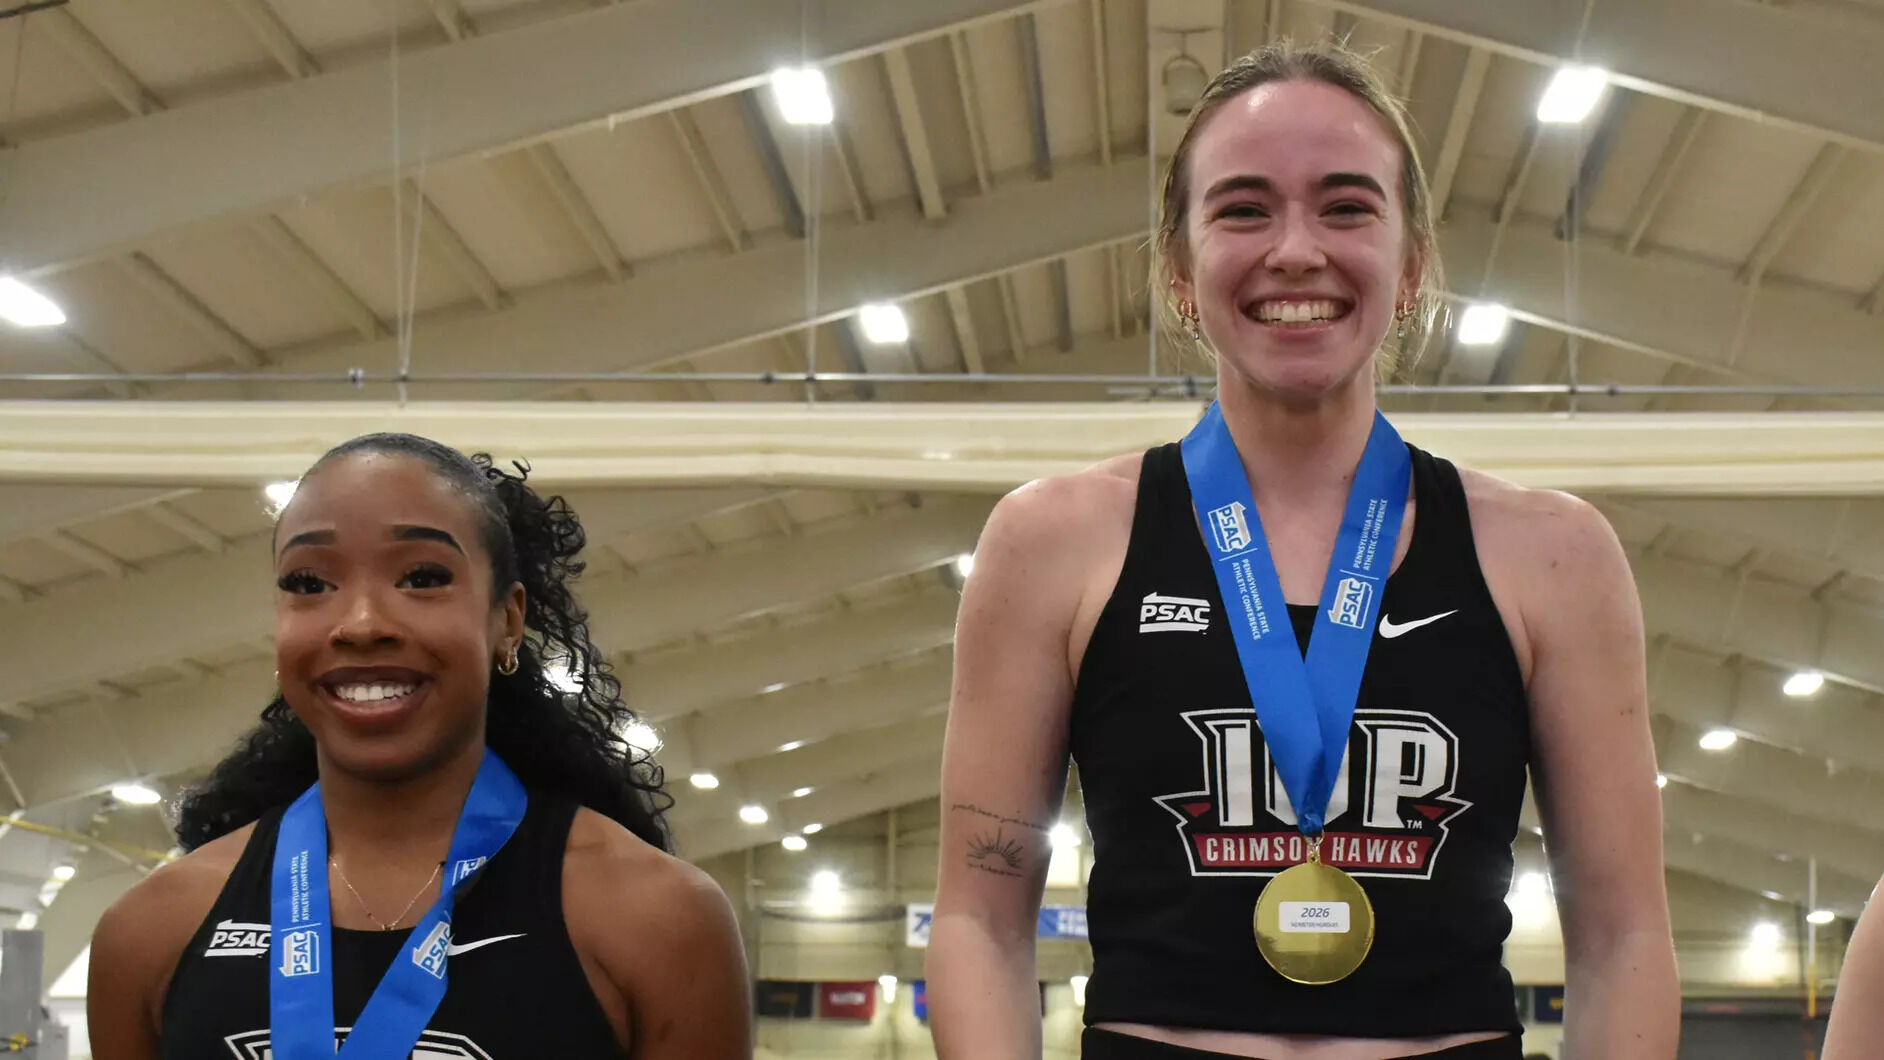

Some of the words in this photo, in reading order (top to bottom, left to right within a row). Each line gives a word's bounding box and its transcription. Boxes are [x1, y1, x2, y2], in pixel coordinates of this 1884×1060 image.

[1219, 505, 1243, 551] PSAC
[1353, 520, 1372, 569] PENNSYLVANIA
[1367, 499, 1378, 518] STATE
[1363, 540, 1378, 571] ATHLETIC
[1371, 499, 1388, 539] CONFERENCE
[1140, 604, 1210, 623] PSAC
[1232, 562, 1248, 594] ATHLETIC
[1242, 594, 1261, 640] CONFERENCE
[1242, 558, 1263, 611] PENNSYLVANIA
[1257, 611, 1270, 634] STATE
[1340, 581, 1364, 626] PSAC
[1407, 819, 1423, 830] TM
[291, 856, 299, 874] STATE
[300, 850, 309, 891] CONFERENCE
[1331, 837, 1418, 864] HAWKS
[291, 874, 299, 923] PENNSYLVANIA
[301, 891, 309, 921] ATHLETIC
[1300, 907, 1330, 918] 2026
[209, 931, 272, 948] PSAC
[293, 935, 308, 974] PSAC
